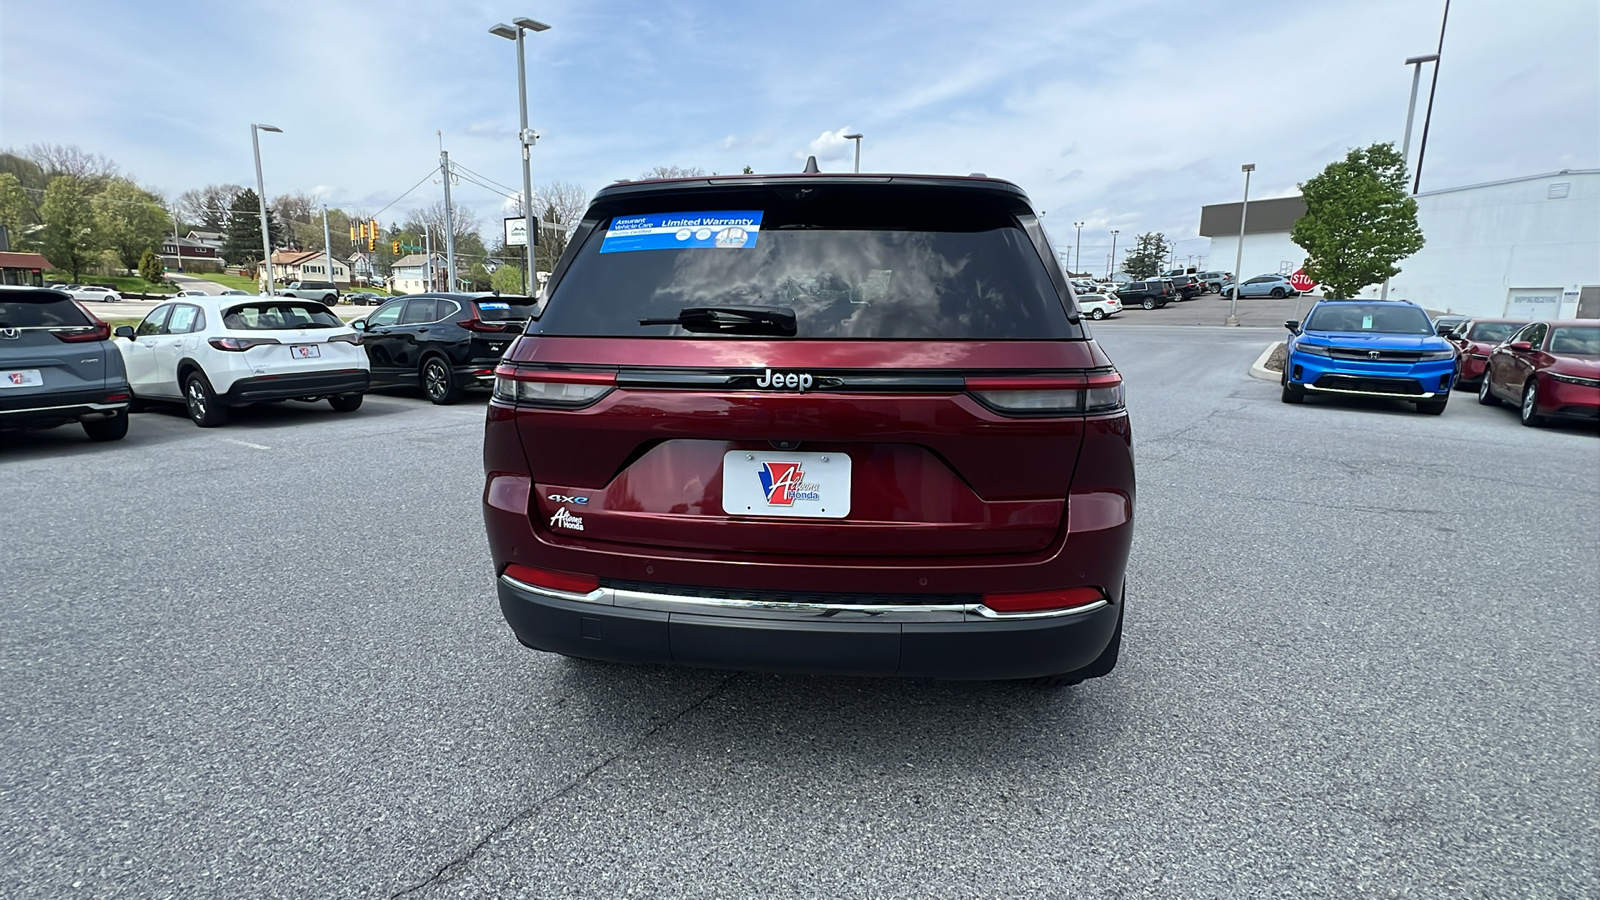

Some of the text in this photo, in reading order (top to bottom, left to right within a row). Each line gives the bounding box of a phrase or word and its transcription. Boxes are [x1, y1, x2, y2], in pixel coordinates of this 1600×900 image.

[661, 218, 754, 227] Limited Warranty
[756, 368, 812, 391] Jeep
[788, 490, 818, 500] Honda
[563, 520, 584, 530] Honda
